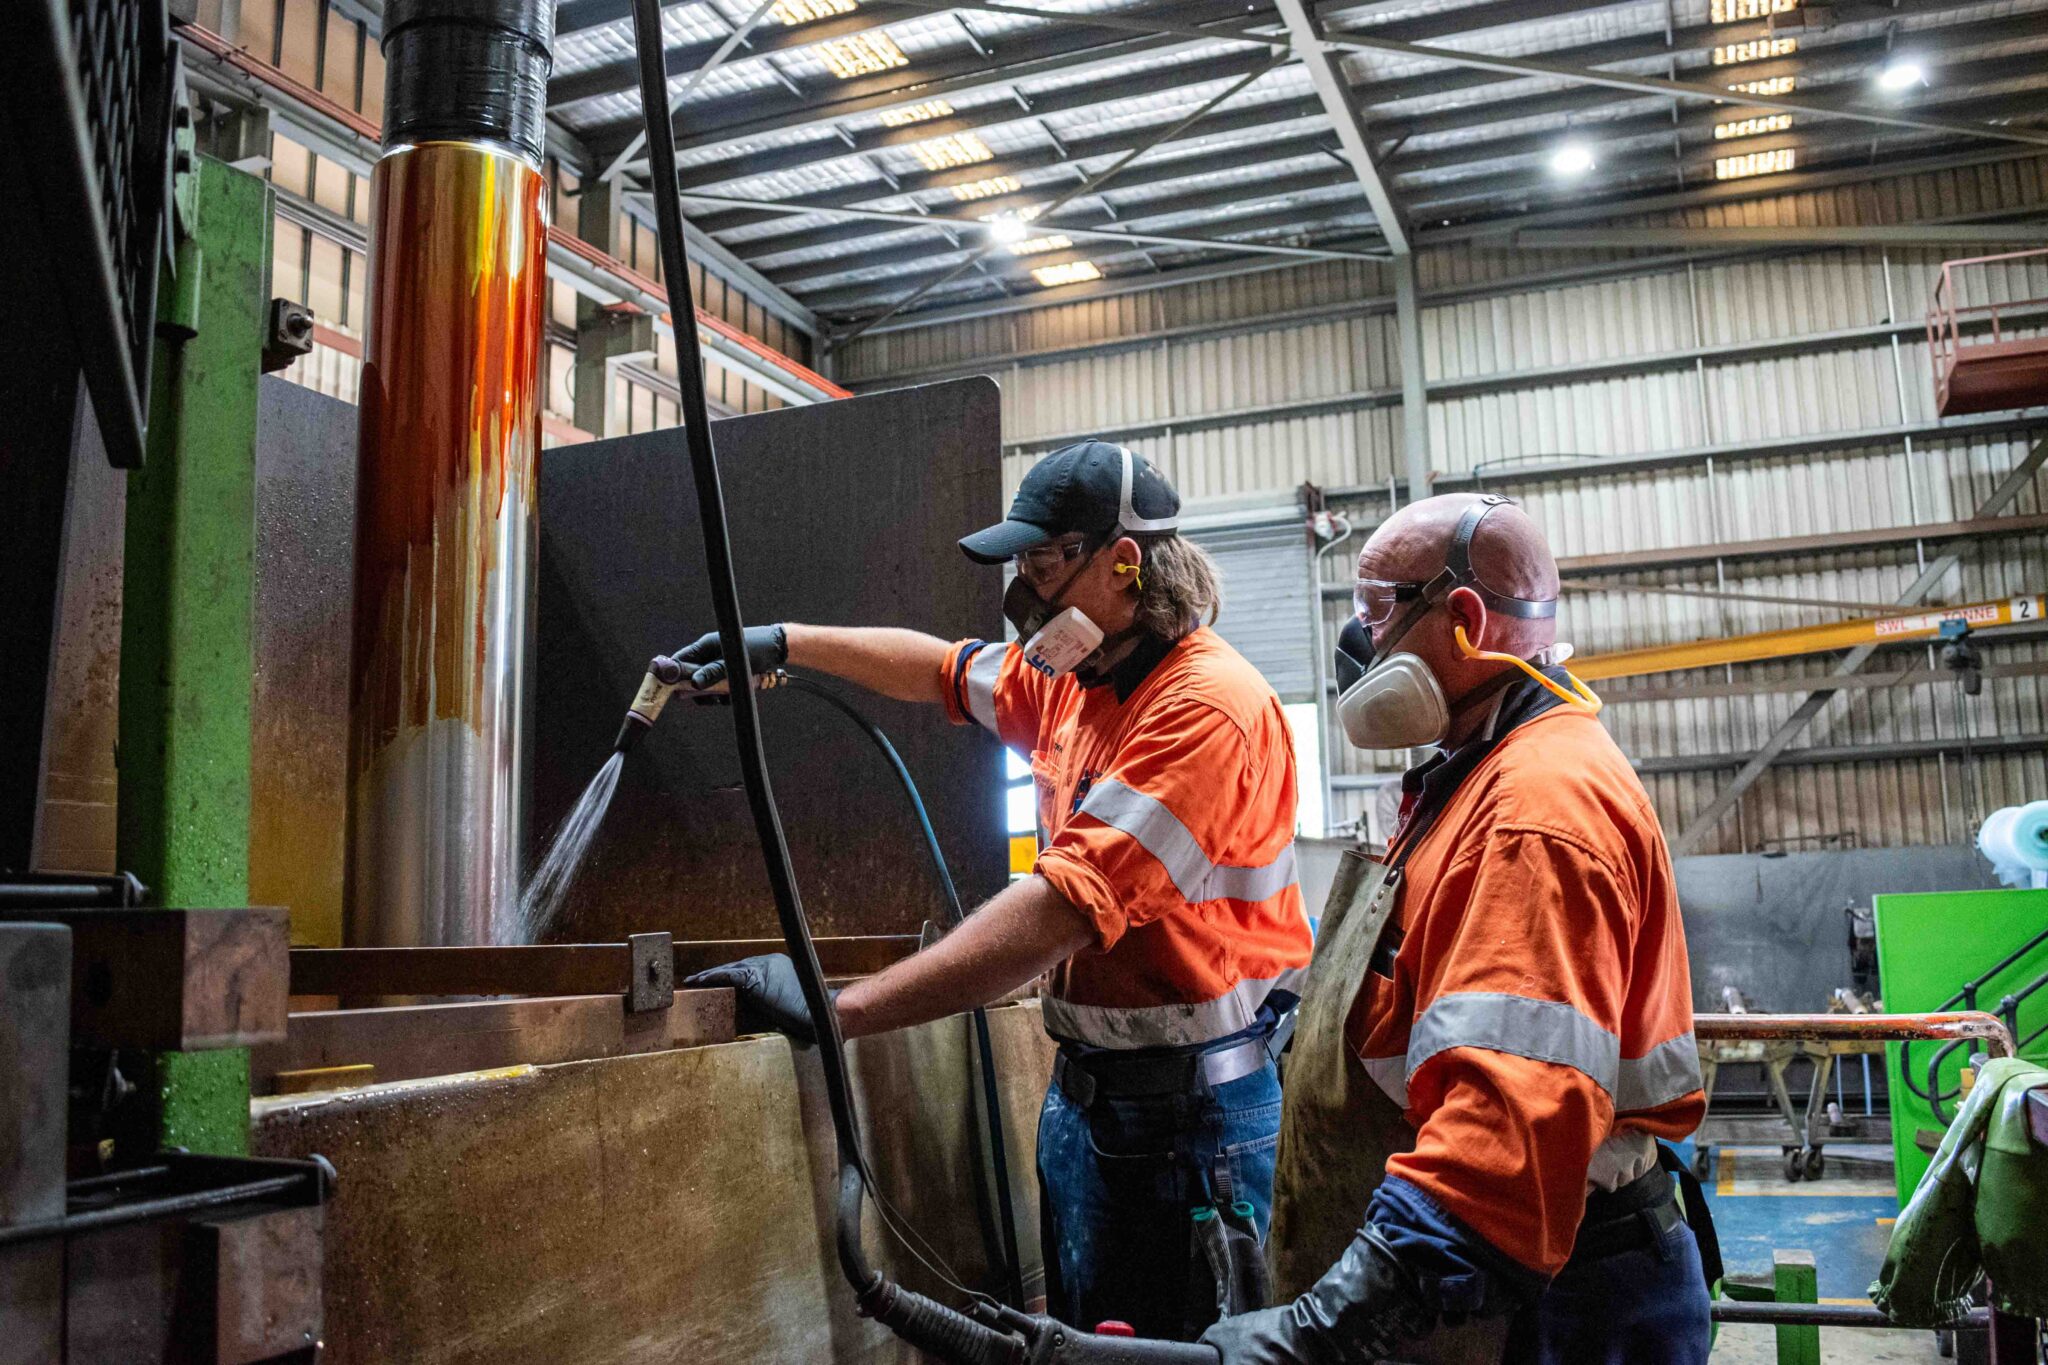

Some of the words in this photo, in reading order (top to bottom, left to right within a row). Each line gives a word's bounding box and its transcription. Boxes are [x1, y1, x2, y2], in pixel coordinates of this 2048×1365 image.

[2019, 600, 2030, 618] 2
[1876, 619, 1909, 633] SWL
[1922, 615, 1928, 628] 1
